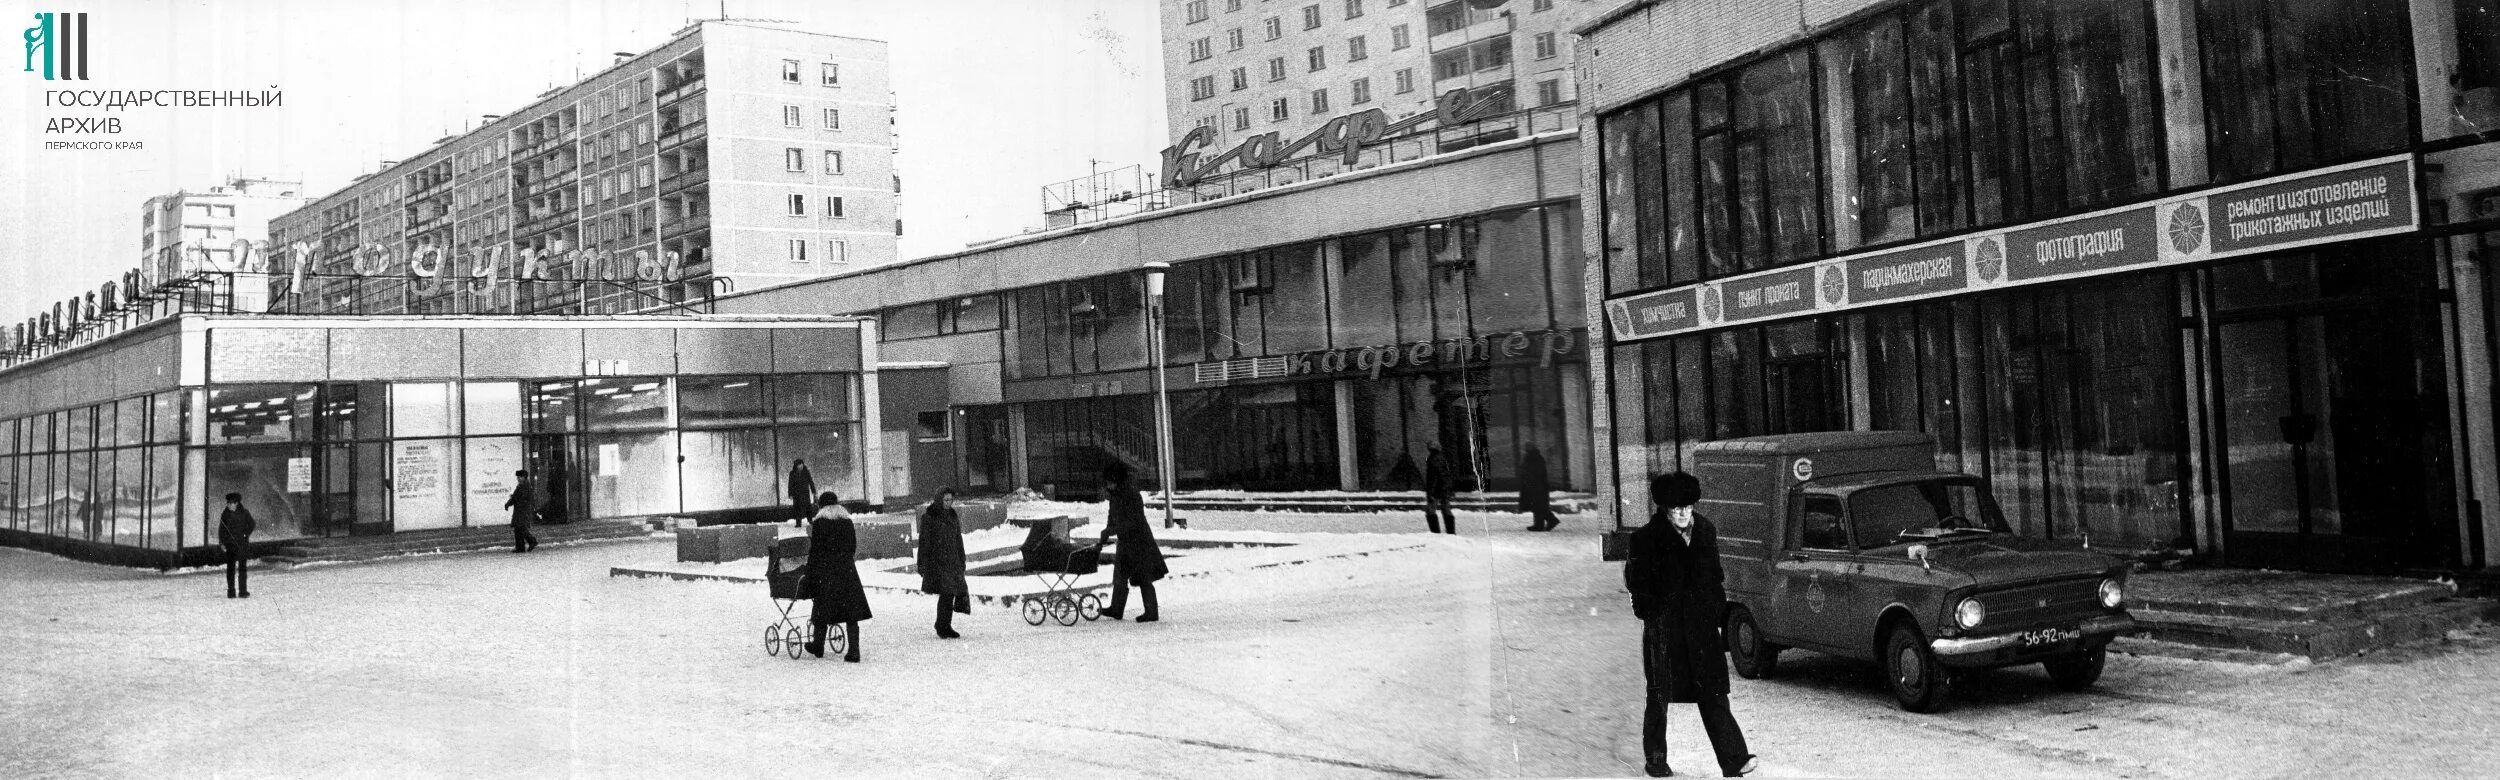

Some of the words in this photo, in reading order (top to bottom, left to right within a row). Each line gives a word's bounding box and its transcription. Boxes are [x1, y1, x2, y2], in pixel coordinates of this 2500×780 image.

[2227, 194, 2276, 222] ремонт
[2288, 175, 2387, 209] изготовление
[2229, 209, 2323, 242] трикотажных
[2326, 195, 2390, 225] изделий
[2036, 227, 2124, 265] фотография
[1862, 256, 1953, 292] парикмахерская
[1640, 301, 1686, 325] химчистка
[1738, 287, 1762, 309] пункт
[1764, 281, 1800, 307] проката
[2024, 627, 2058, 646] 56-92
